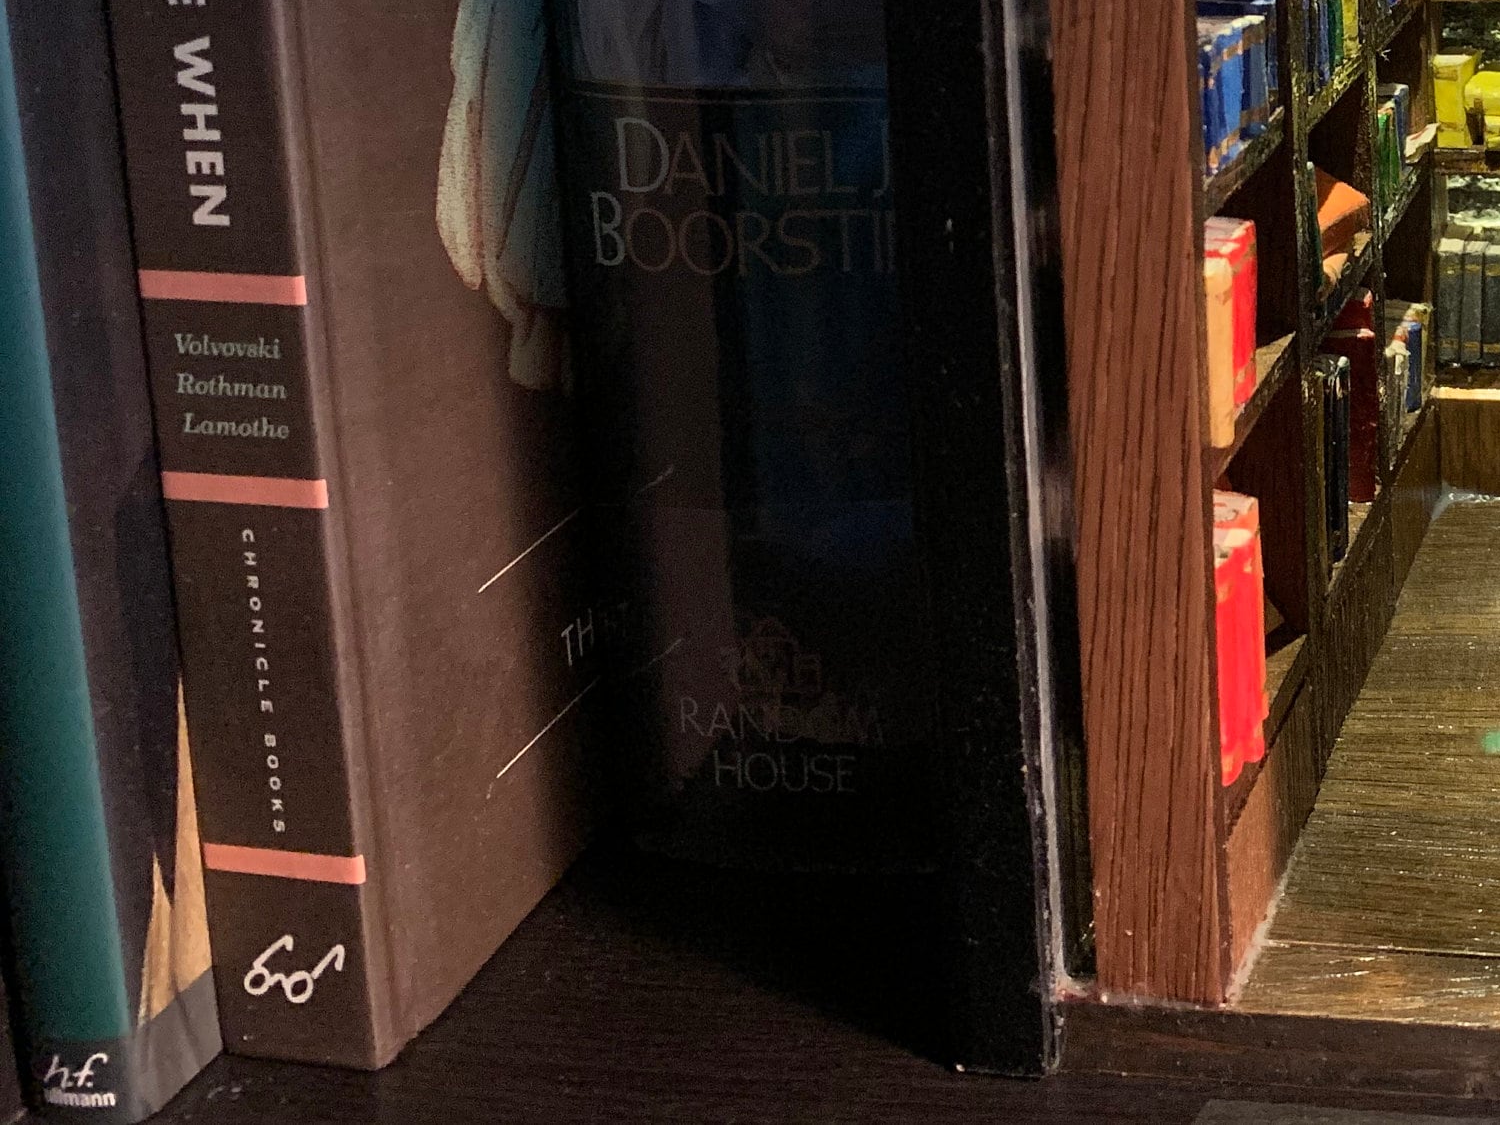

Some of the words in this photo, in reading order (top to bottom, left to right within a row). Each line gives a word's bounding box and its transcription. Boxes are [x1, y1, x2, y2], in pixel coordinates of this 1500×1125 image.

[174, 36, 231, 226] WHEN
[615, 116, 858, 196] DANIEL
[589, 190, 896, 276] BOORSTI
[174, 332, 282, 362] Volvovski
[176, 373, 288, 402] Rothman
[183, 413, 290, 441] Lamothe
[241, 529, 273, 715] CHRONICLE
[264, 734, 287, 834] BOOKS
[680, 695, 884, 744] RANDOM
[713, 749, 857, 793] HOUSE
